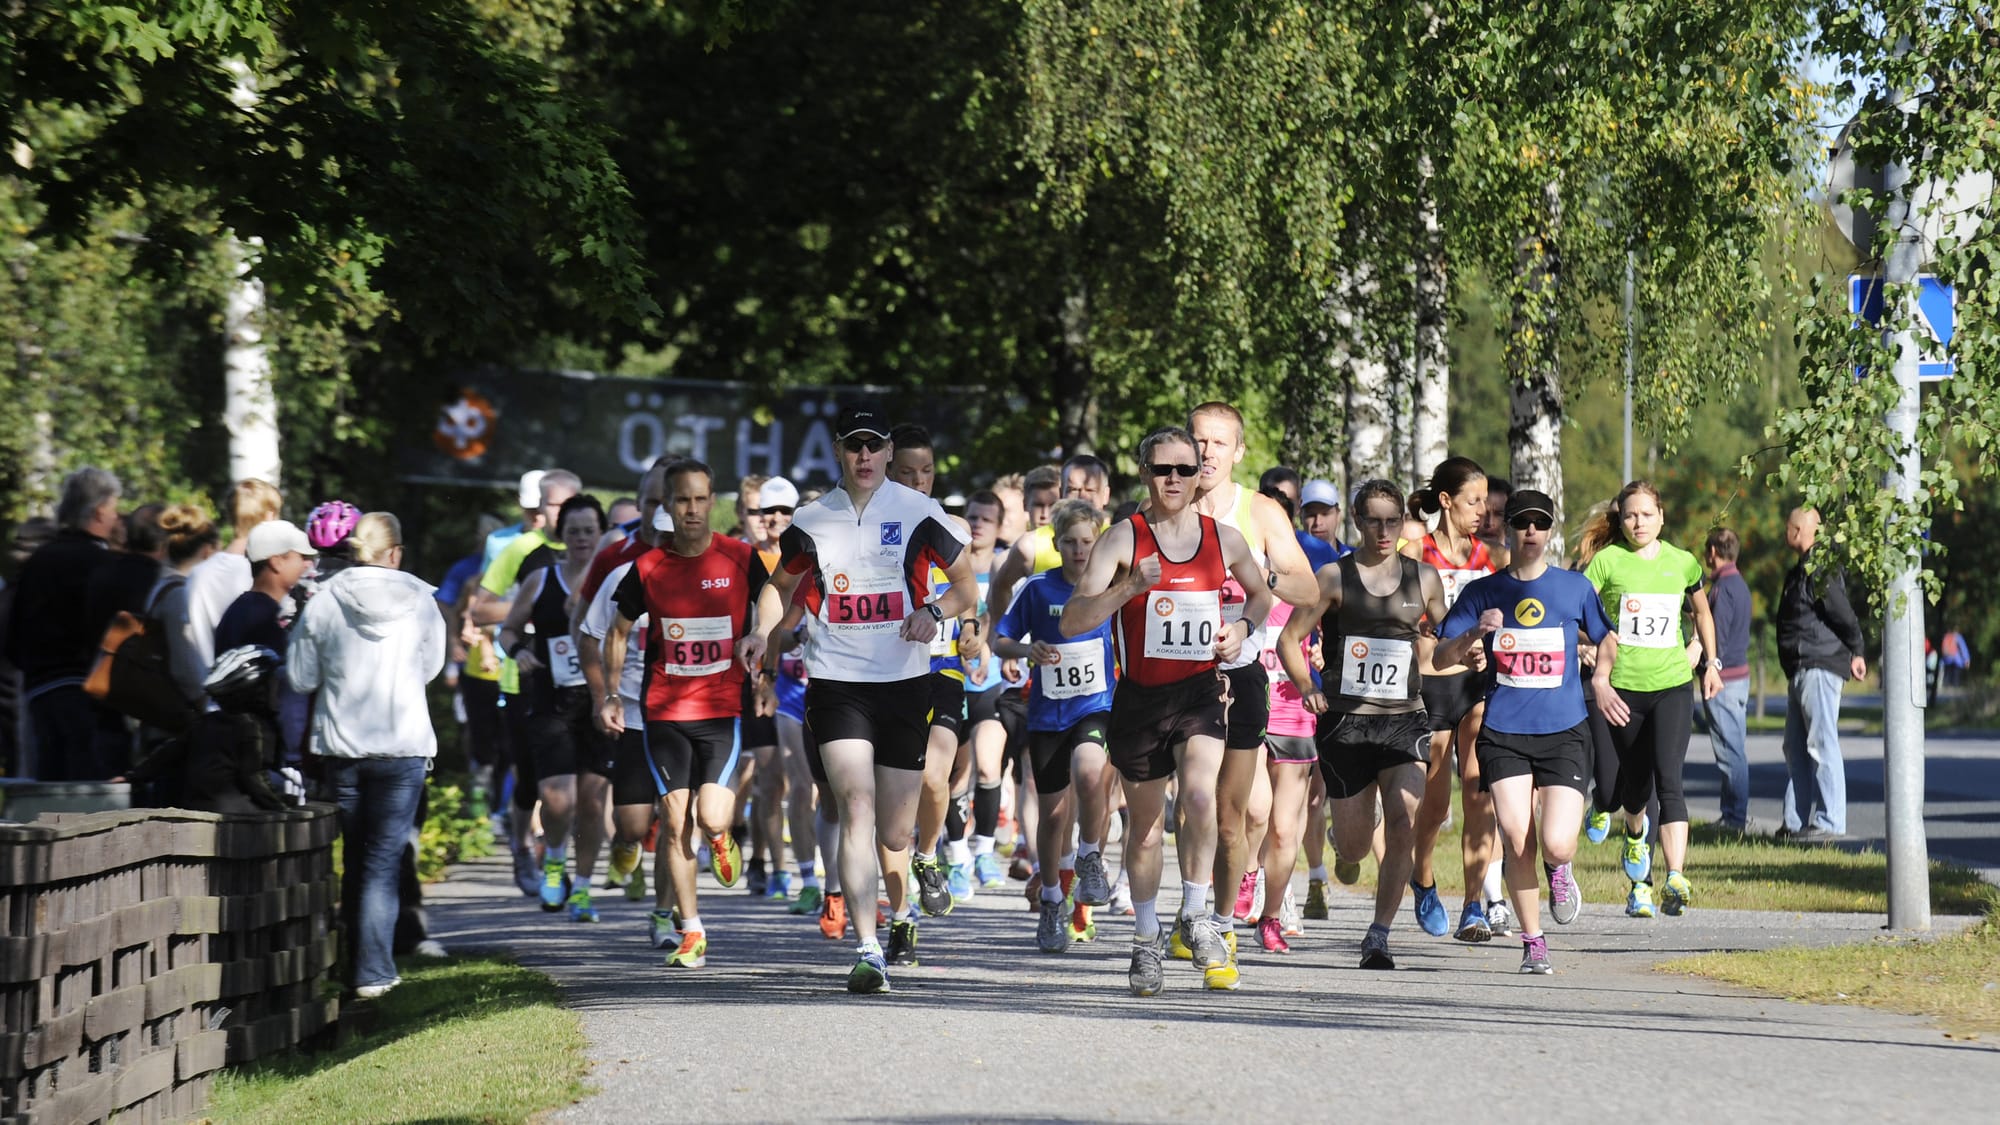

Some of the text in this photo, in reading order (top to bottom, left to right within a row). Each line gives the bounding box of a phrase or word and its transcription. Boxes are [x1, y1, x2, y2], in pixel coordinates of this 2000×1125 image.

[701, 578, 730, 589] SI-SU
[839, 592, 890, 621] 504
[1161, 620, 1212, 646] 110
[1631, 616, 1669, 636] 137
[674, 641, 721, 665] 690
[1505, 653, 1552, 675] 708
[1054, 663, 1095, 688] 185
[1356, 662, 1398, 685] 102
